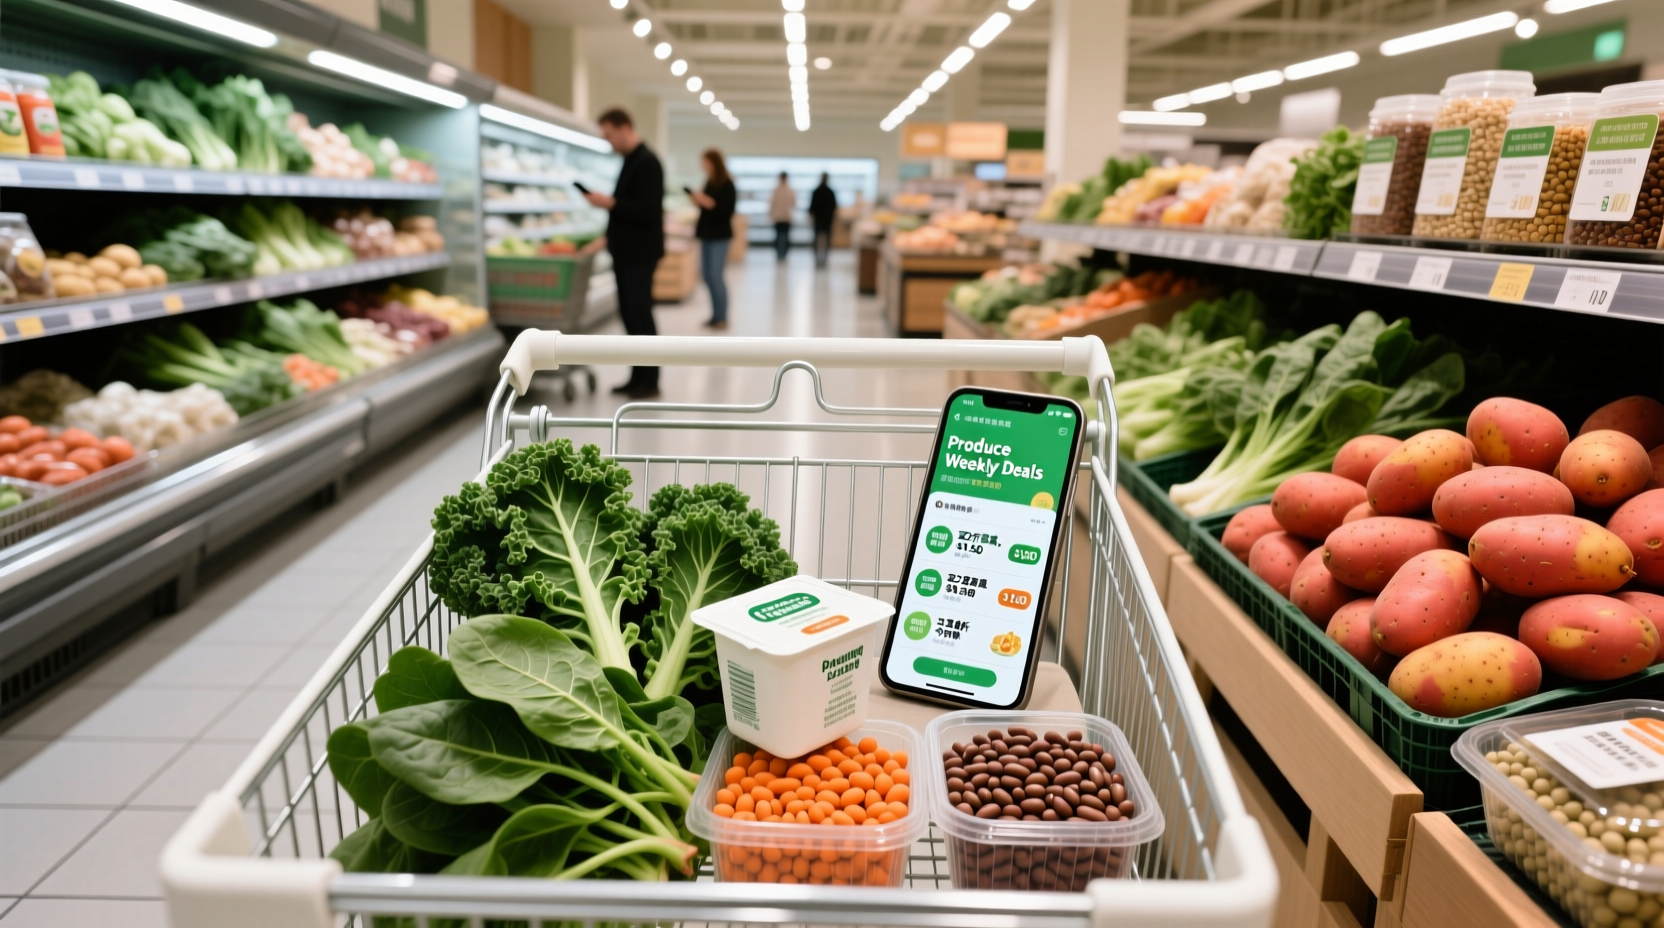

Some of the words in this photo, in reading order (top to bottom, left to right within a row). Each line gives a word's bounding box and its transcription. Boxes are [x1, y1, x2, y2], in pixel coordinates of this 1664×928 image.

[947, 435, 1012, 456] Produce
[945, 453, 1000, 478] Weekly
[1001, 460, 1044, 480] Deals
